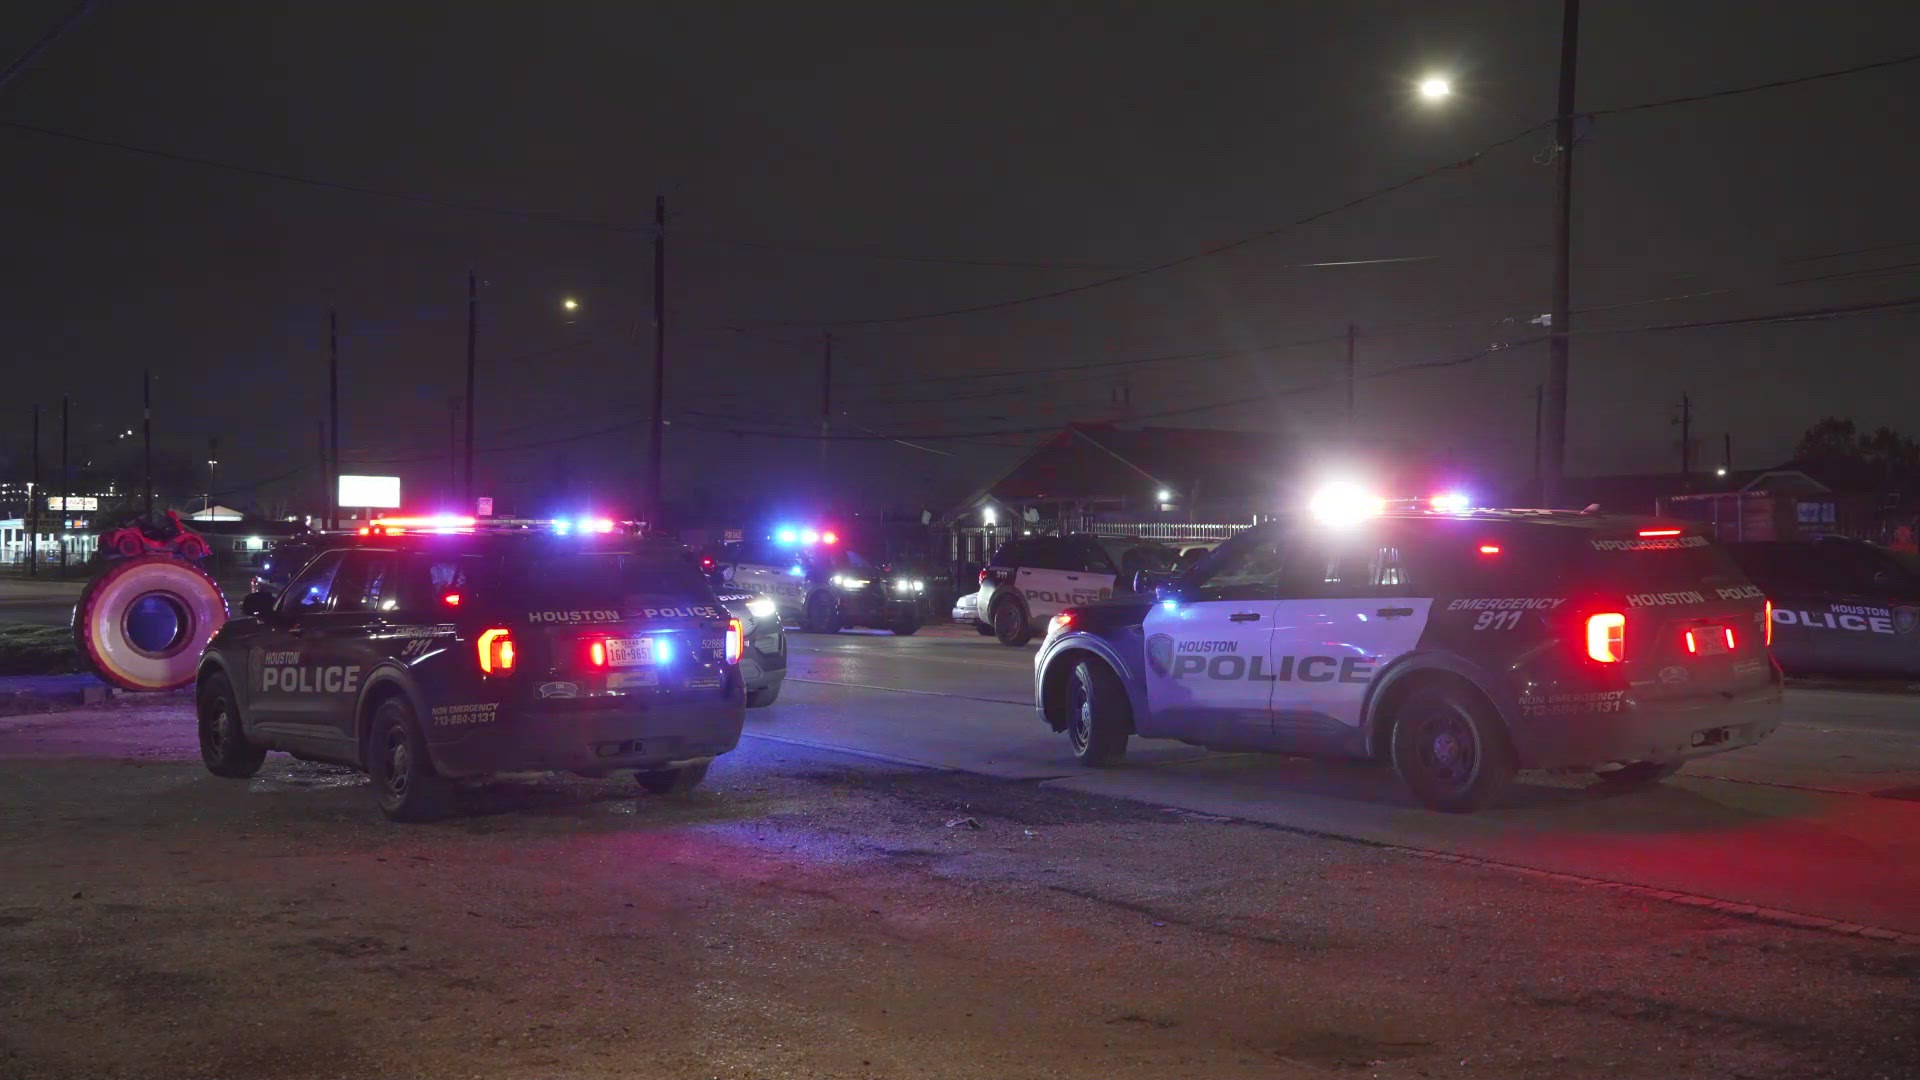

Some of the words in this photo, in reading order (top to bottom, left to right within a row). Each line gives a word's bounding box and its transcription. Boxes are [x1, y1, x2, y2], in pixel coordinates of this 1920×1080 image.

[1447, 598, 1567, 611] EMERGENCY
[1626, 590, 1705, 607] HOUSTON
[528, 609, 620, 622] HOUSTON
[644, 606, 718, 618] POLICE
[1830, 604, 1890, 617] HOUSTON
[1473, 610, 1524, 630] 911
[1771, 608, 1896, 634] OLICE
[401, 638, 432, 655] 911
[1177, 640, 1239, 652] HOUSTON
[265, 651, 301, 664] HOUSTON
[1172, 655, 1377, 683] POLICE
[262, 665, 360, 693] POLICE
[431, 706, 447, 717] NON
[449, 702, 500, 713] EMERGENCY
